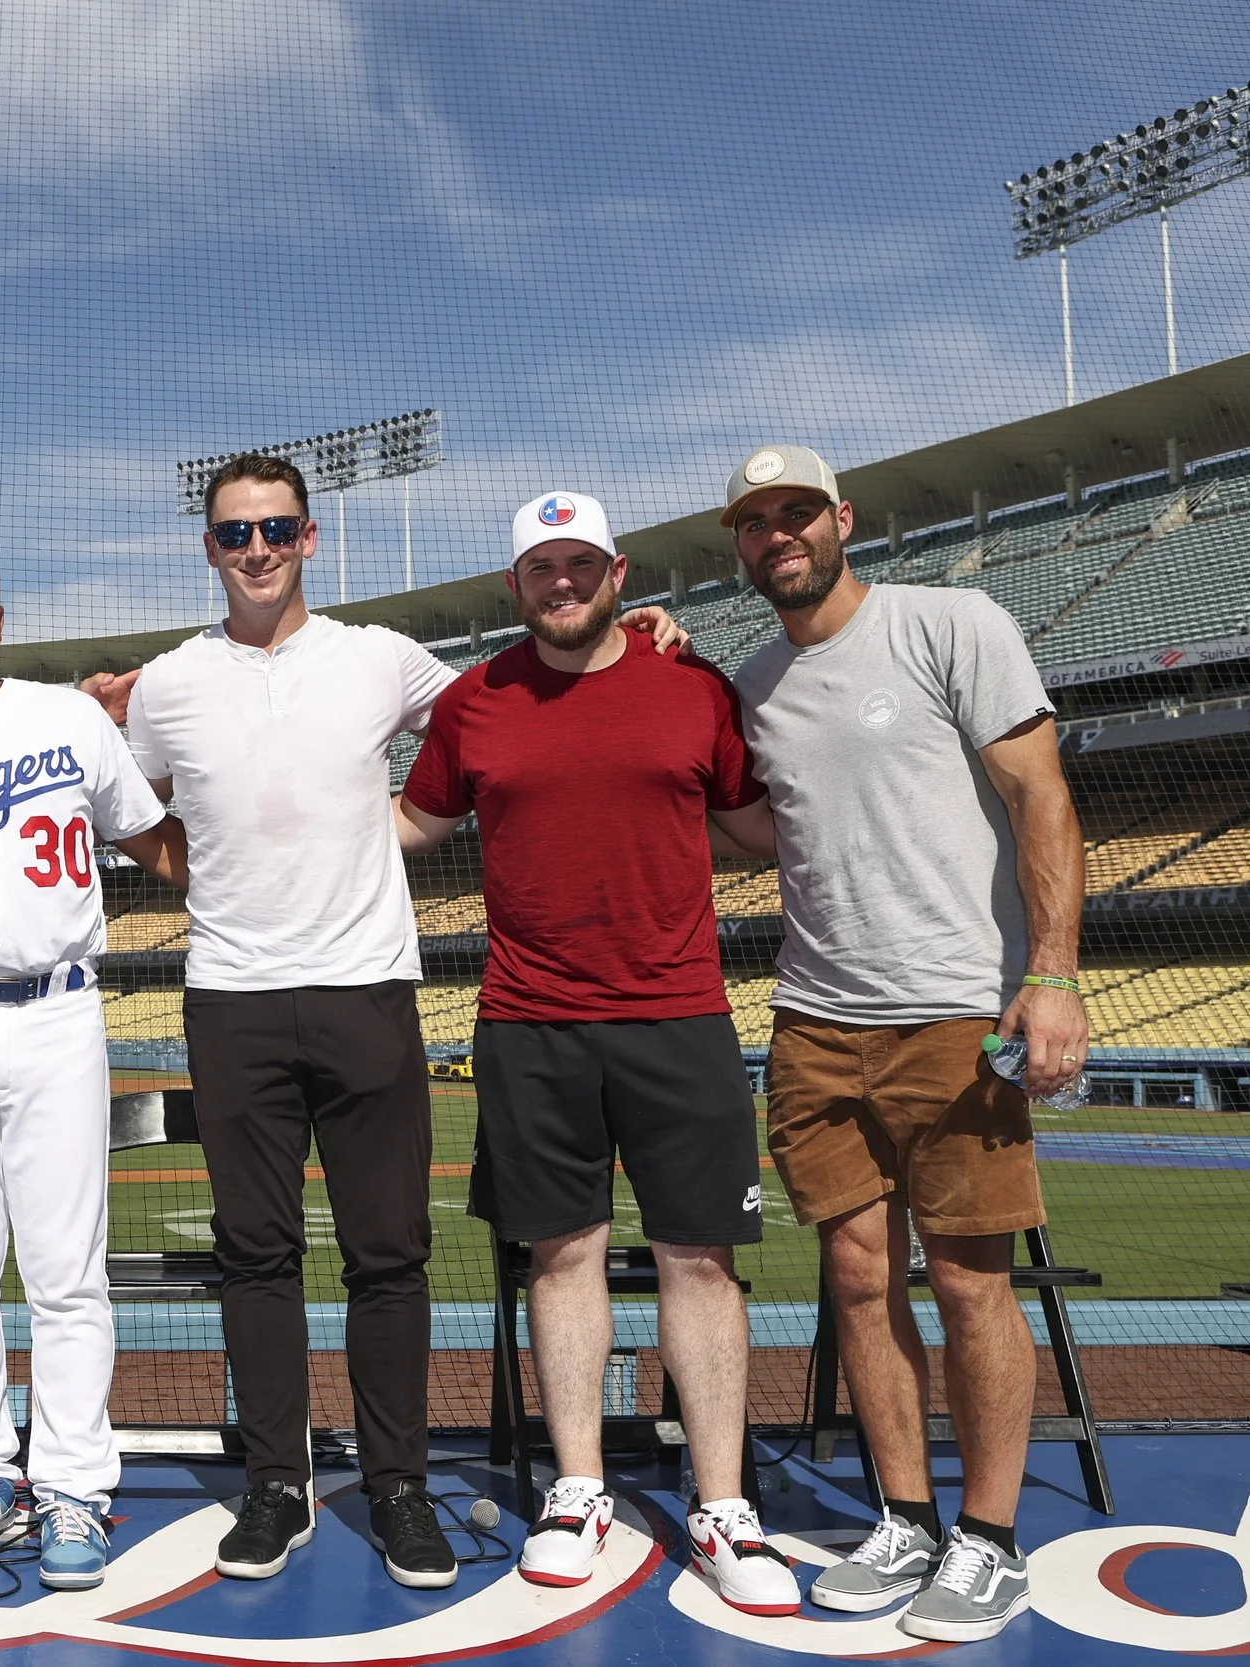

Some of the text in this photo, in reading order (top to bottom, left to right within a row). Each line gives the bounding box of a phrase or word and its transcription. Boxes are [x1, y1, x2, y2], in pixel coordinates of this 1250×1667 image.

[754, 461, 775, 472] HOPE
[1200, 649, 1232, 662] Suite
[1050, 661, 1146, 686] OF AMERICA
[19, 815, 92, 888] 30
[741, 1541, 762, 1549] NIKE
